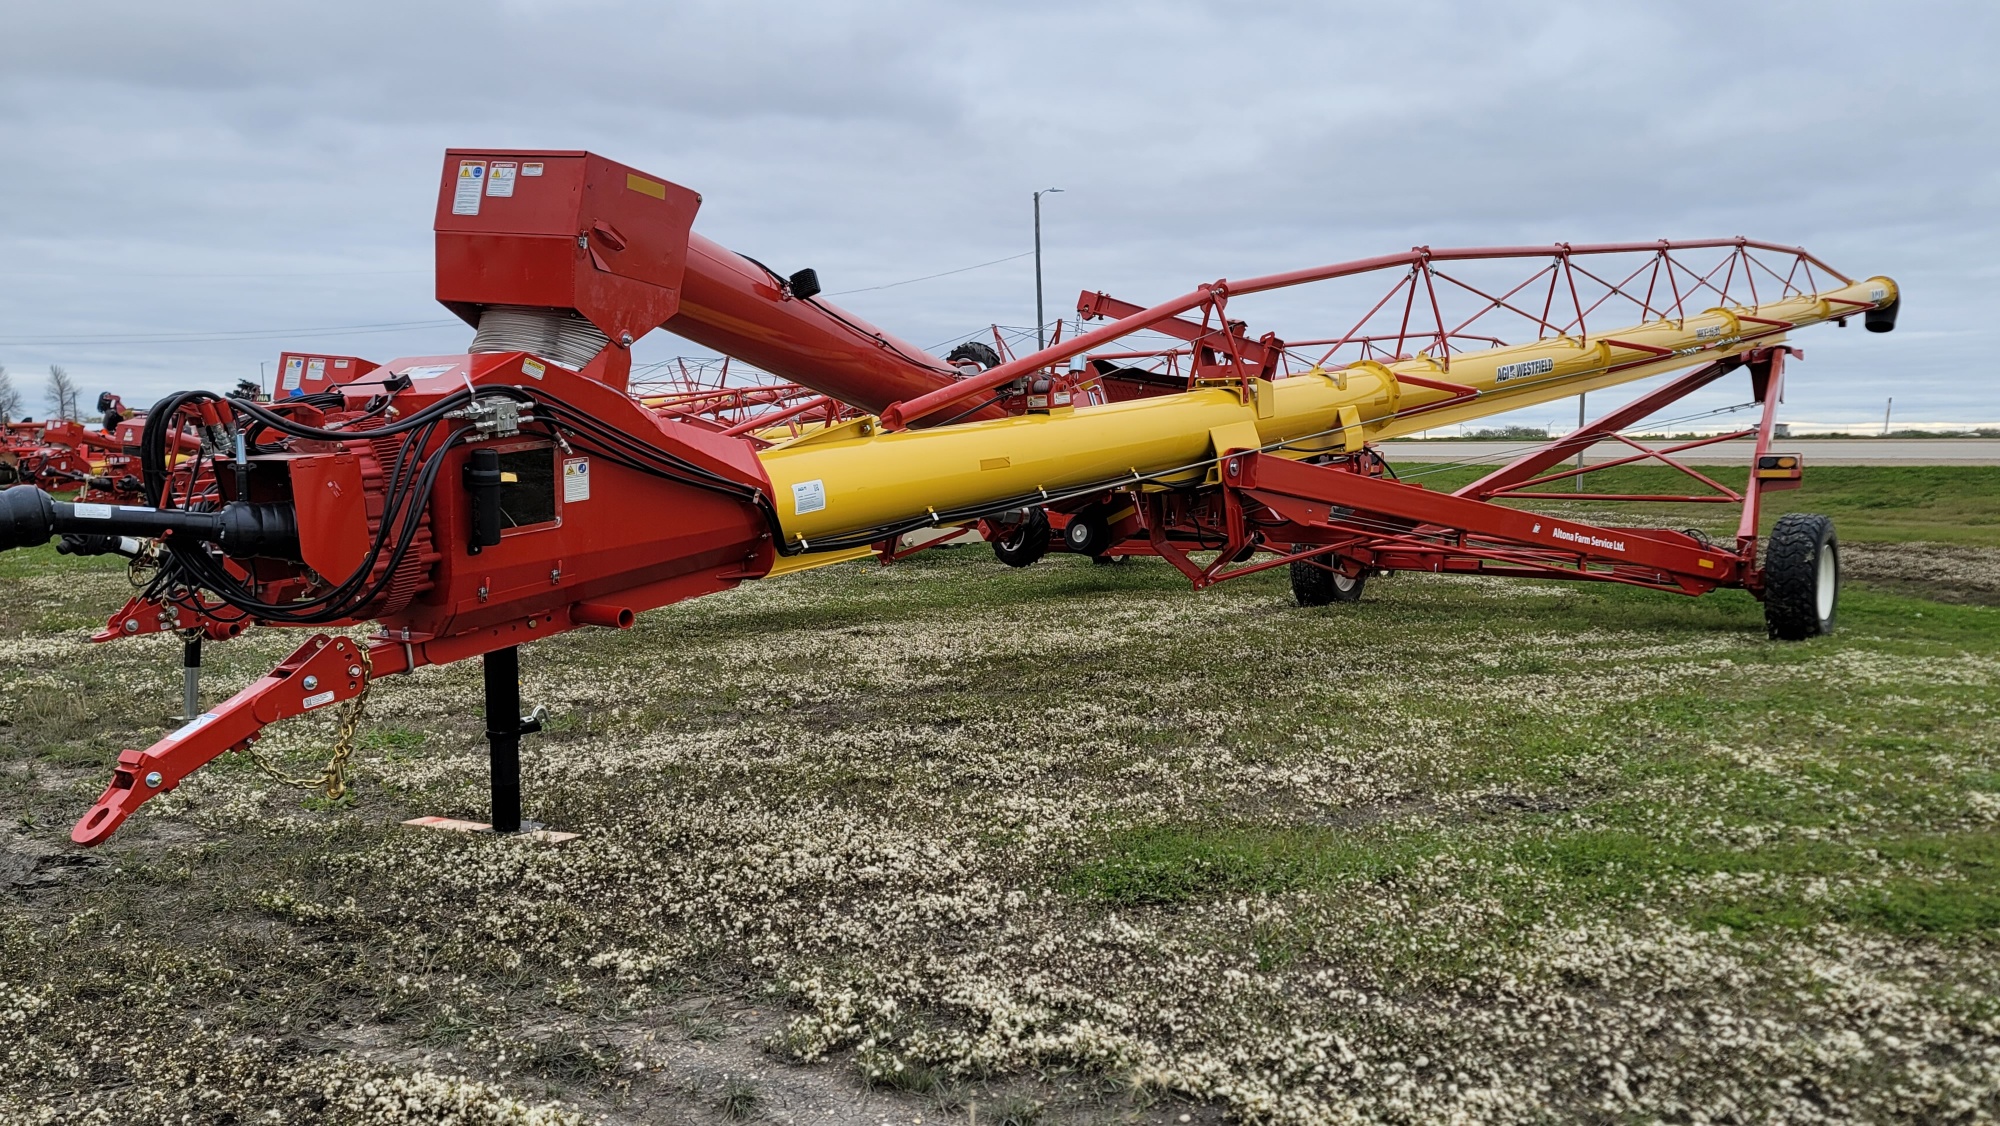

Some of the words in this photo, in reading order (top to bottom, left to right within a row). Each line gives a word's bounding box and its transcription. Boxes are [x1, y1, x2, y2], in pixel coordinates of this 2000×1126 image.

[1497, 367, 1509, 382] AGI
[1516, 359, 1553, 377] WESTFIELD
[1553, 528, 1573, 541] Altona
[1575, 533, 1590, 544] Farm
[1591, 536, 1613, 549] Service
[1614, 541, 1625, 551] Ltd.
